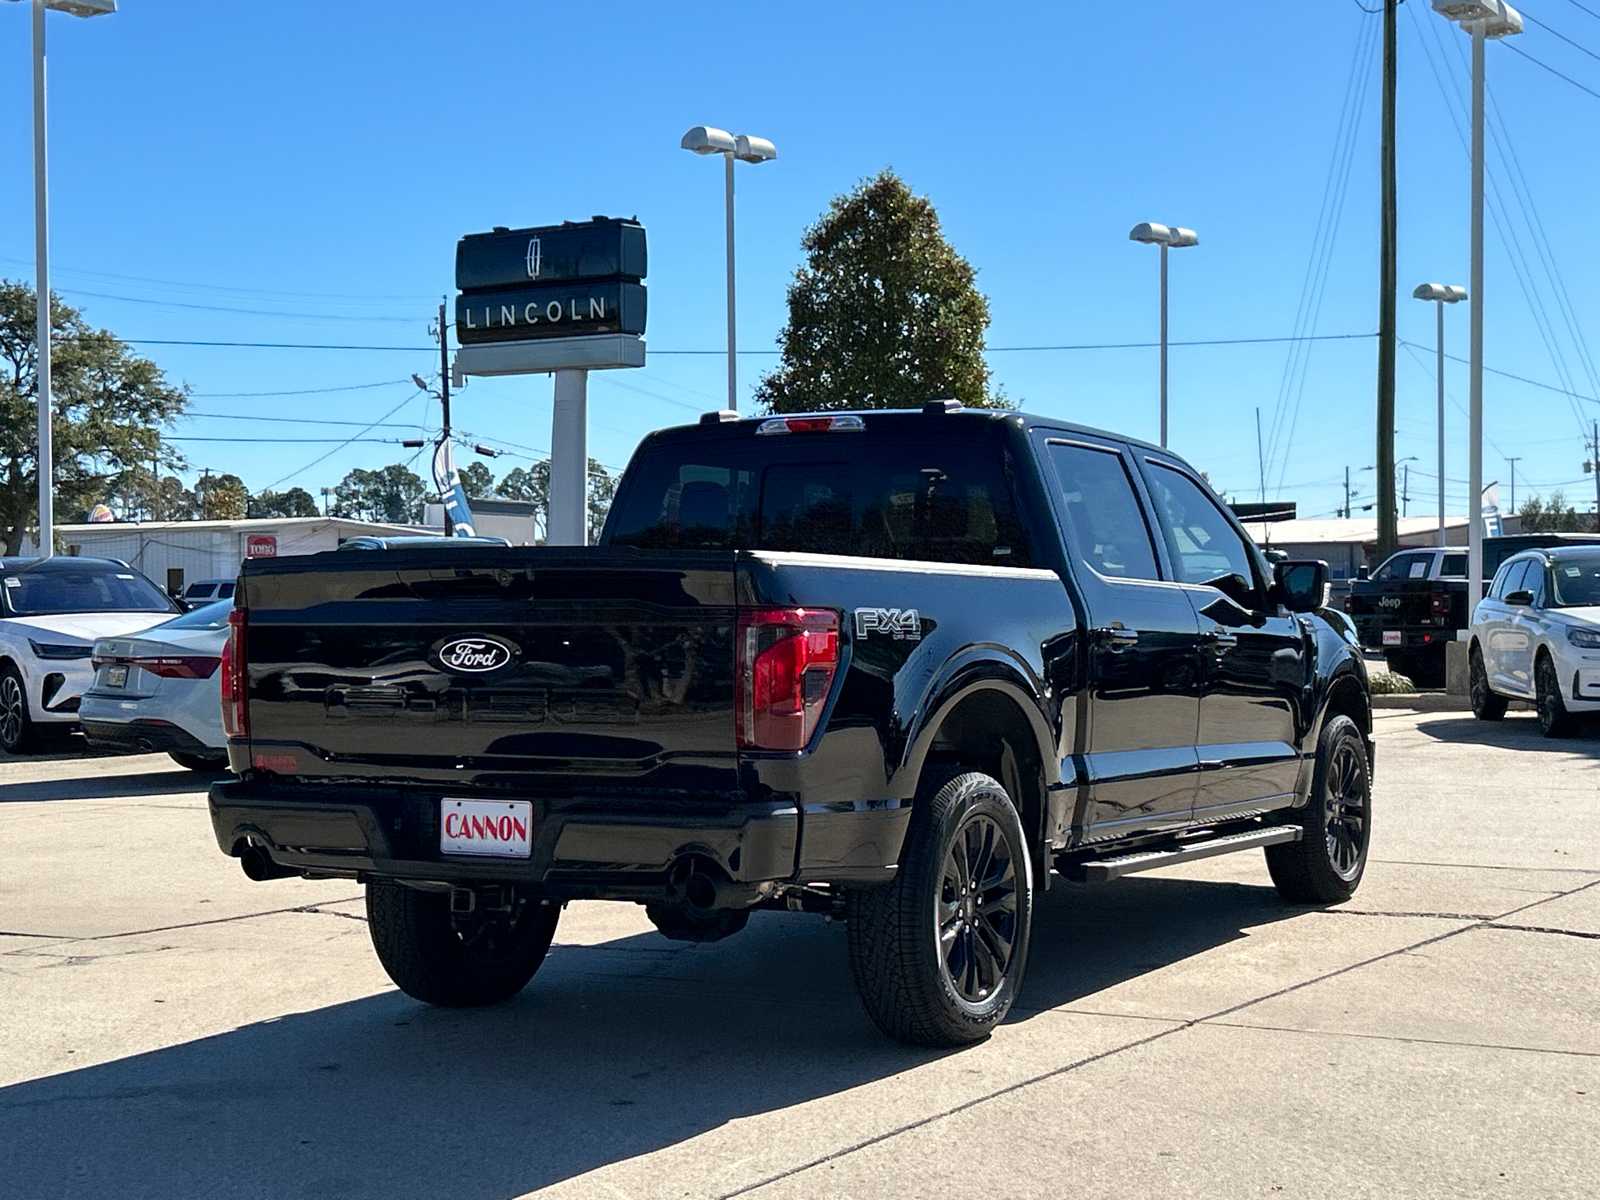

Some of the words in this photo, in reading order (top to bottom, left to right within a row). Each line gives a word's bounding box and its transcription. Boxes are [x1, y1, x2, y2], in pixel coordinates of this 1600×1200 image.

[465, 297, 605, 329] LINCOLN
[249, 544, 275, 555] TORO
[1378, 596, 1401, 609] Jeep
[854, 607, 921, 640] FX4
[451, 643, 500, 666] Ford
[445, 812, 527, 842] CANNON
